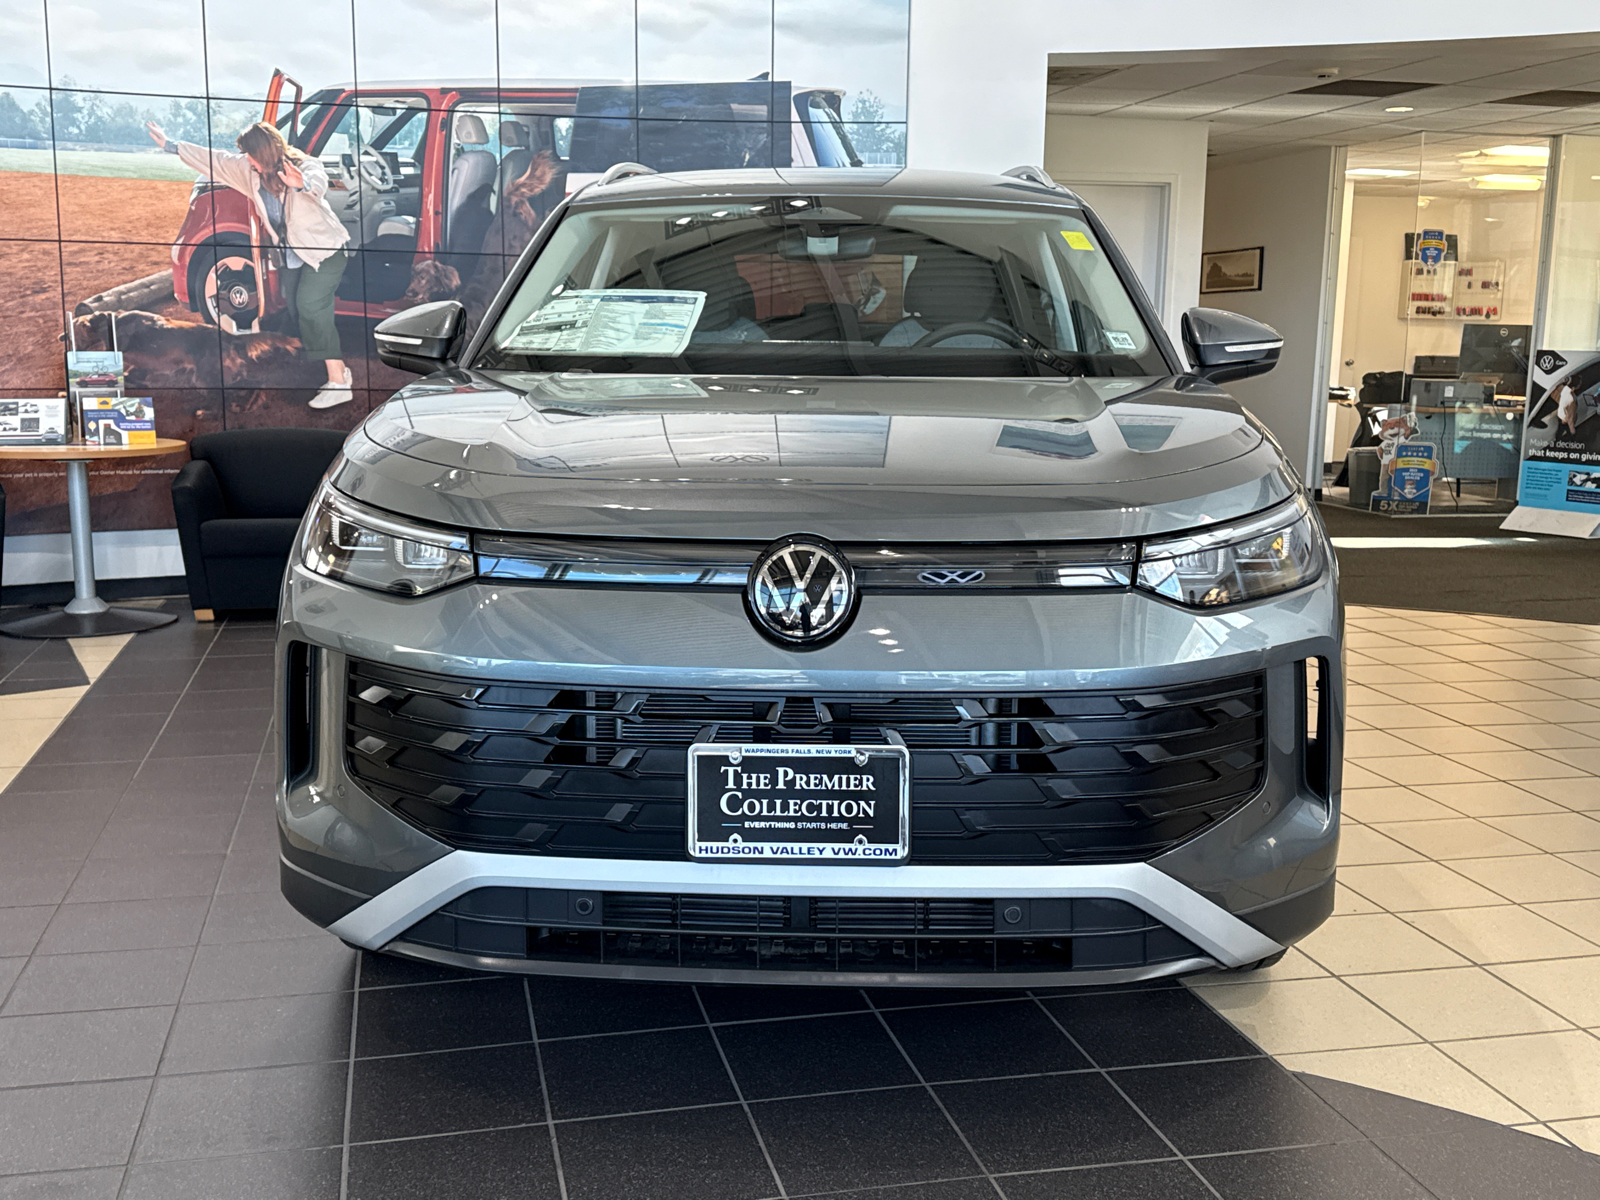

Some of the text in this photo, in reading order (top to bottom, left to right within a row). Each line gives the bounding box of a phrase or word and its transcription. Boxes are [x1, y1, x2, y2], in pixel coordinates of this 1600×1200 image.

[1529, 438, 1548, 446] Make
[1555, 440, 1586, 449] decision
[1545, 449, 1568, 460] keeps
[1379, 500, 1398, 511] 5X
[719, 765, 876, 791] THE PREMIER
[719, 791, 876, 817] COLLECTION
[744, 821, 796, 829] EVERYTHING
[698, 845, 898, 857] HUDSON VALLEY VW.COM
